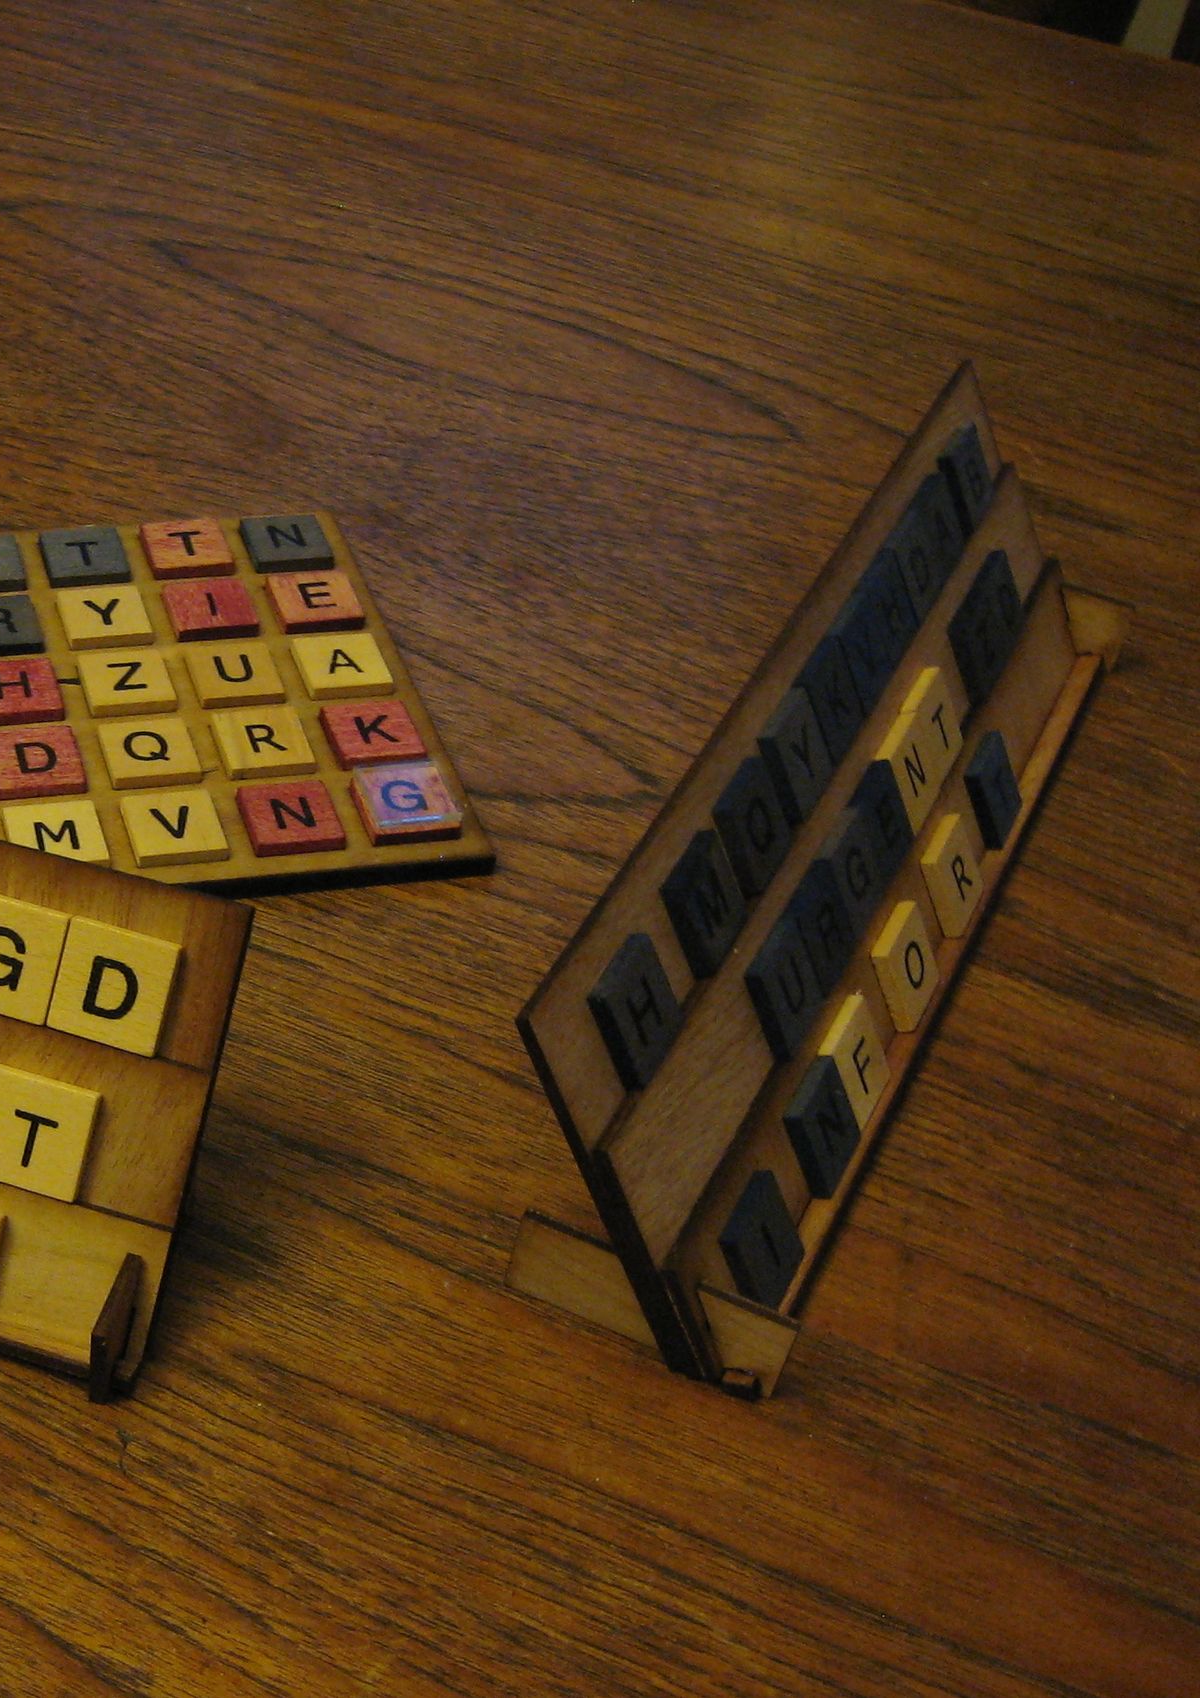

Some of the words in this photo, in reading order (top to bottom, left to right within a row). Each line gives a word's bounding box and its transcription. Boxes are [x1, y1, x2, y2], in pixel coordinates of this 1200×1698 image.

[66, 541, 101, 565] T
[168, 531, 205, 556] T
[267, 523, 307, 548] N
[83, 598, 120, 626] Y
[206, 592, 221, 618] I
[297, 582, 338, 609] E
[106, 661, 149, 690] Z
[213, 655, 254, 683] U
[328, 648, 363, 675] A
[13, 742, 57, 773] D
[123, 731, 169, 763] Q
[251, 723, 290, 753] R
[357, 714, 400, 744] K
[149, 807, 190, 839] V
[271, 796, 317, 829] N
[381, 780, 426, 811] G
[15, 1108, 59, 1169] T
